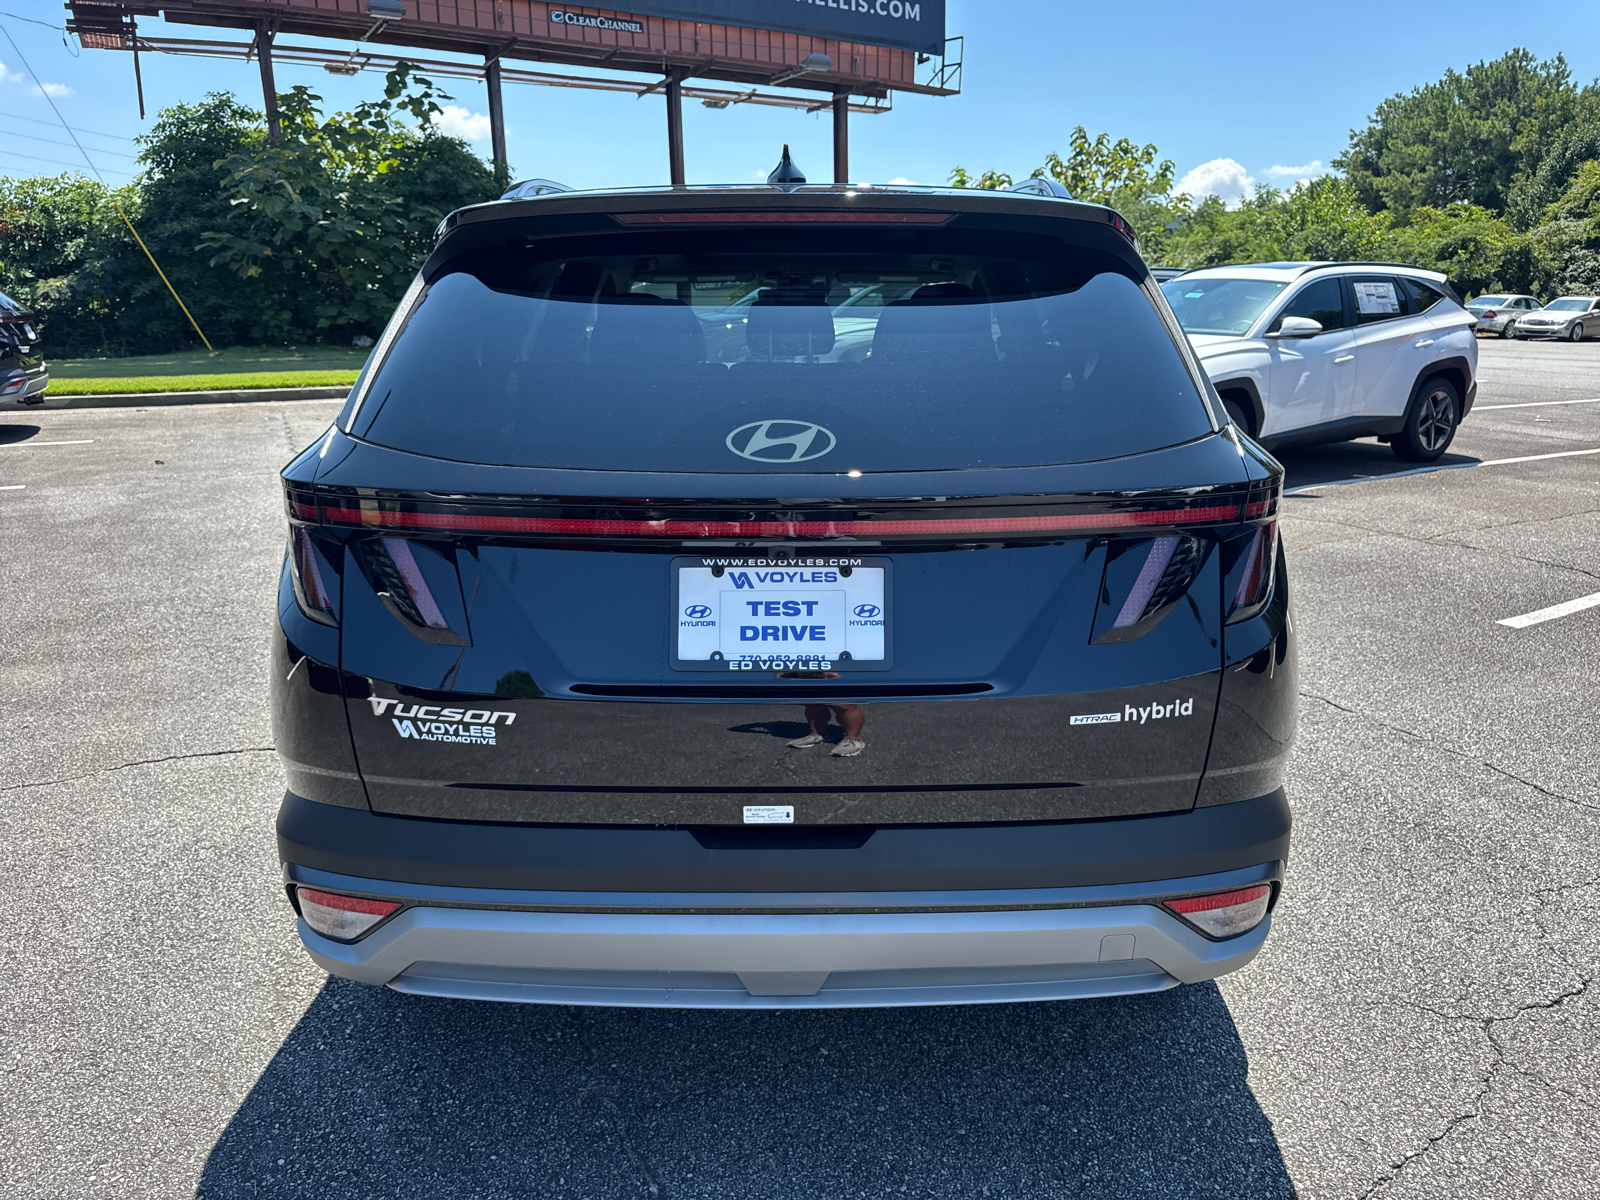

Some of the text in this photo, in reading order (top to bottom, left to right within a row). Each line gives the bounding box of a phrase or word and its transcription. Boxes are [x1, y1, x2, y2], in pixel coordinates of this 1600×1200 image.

[796, 0, 921, 22] LLIS.COM
[702, 558, 862, 566] WWW.EDVOYLES.COM
[755, 571, 838, 583] VOYLES
[746, 600, 819, 617] TEST
[740, 625, 826, 642] DRIVE
[729, 660, 832, 670] ED VOYLES
[1073, 697, 1194, 725] HTRAC hybrid
[417, 721, 496, 738] VOYLES
[420, 733, 497, 745] AUTOMOTIVE
